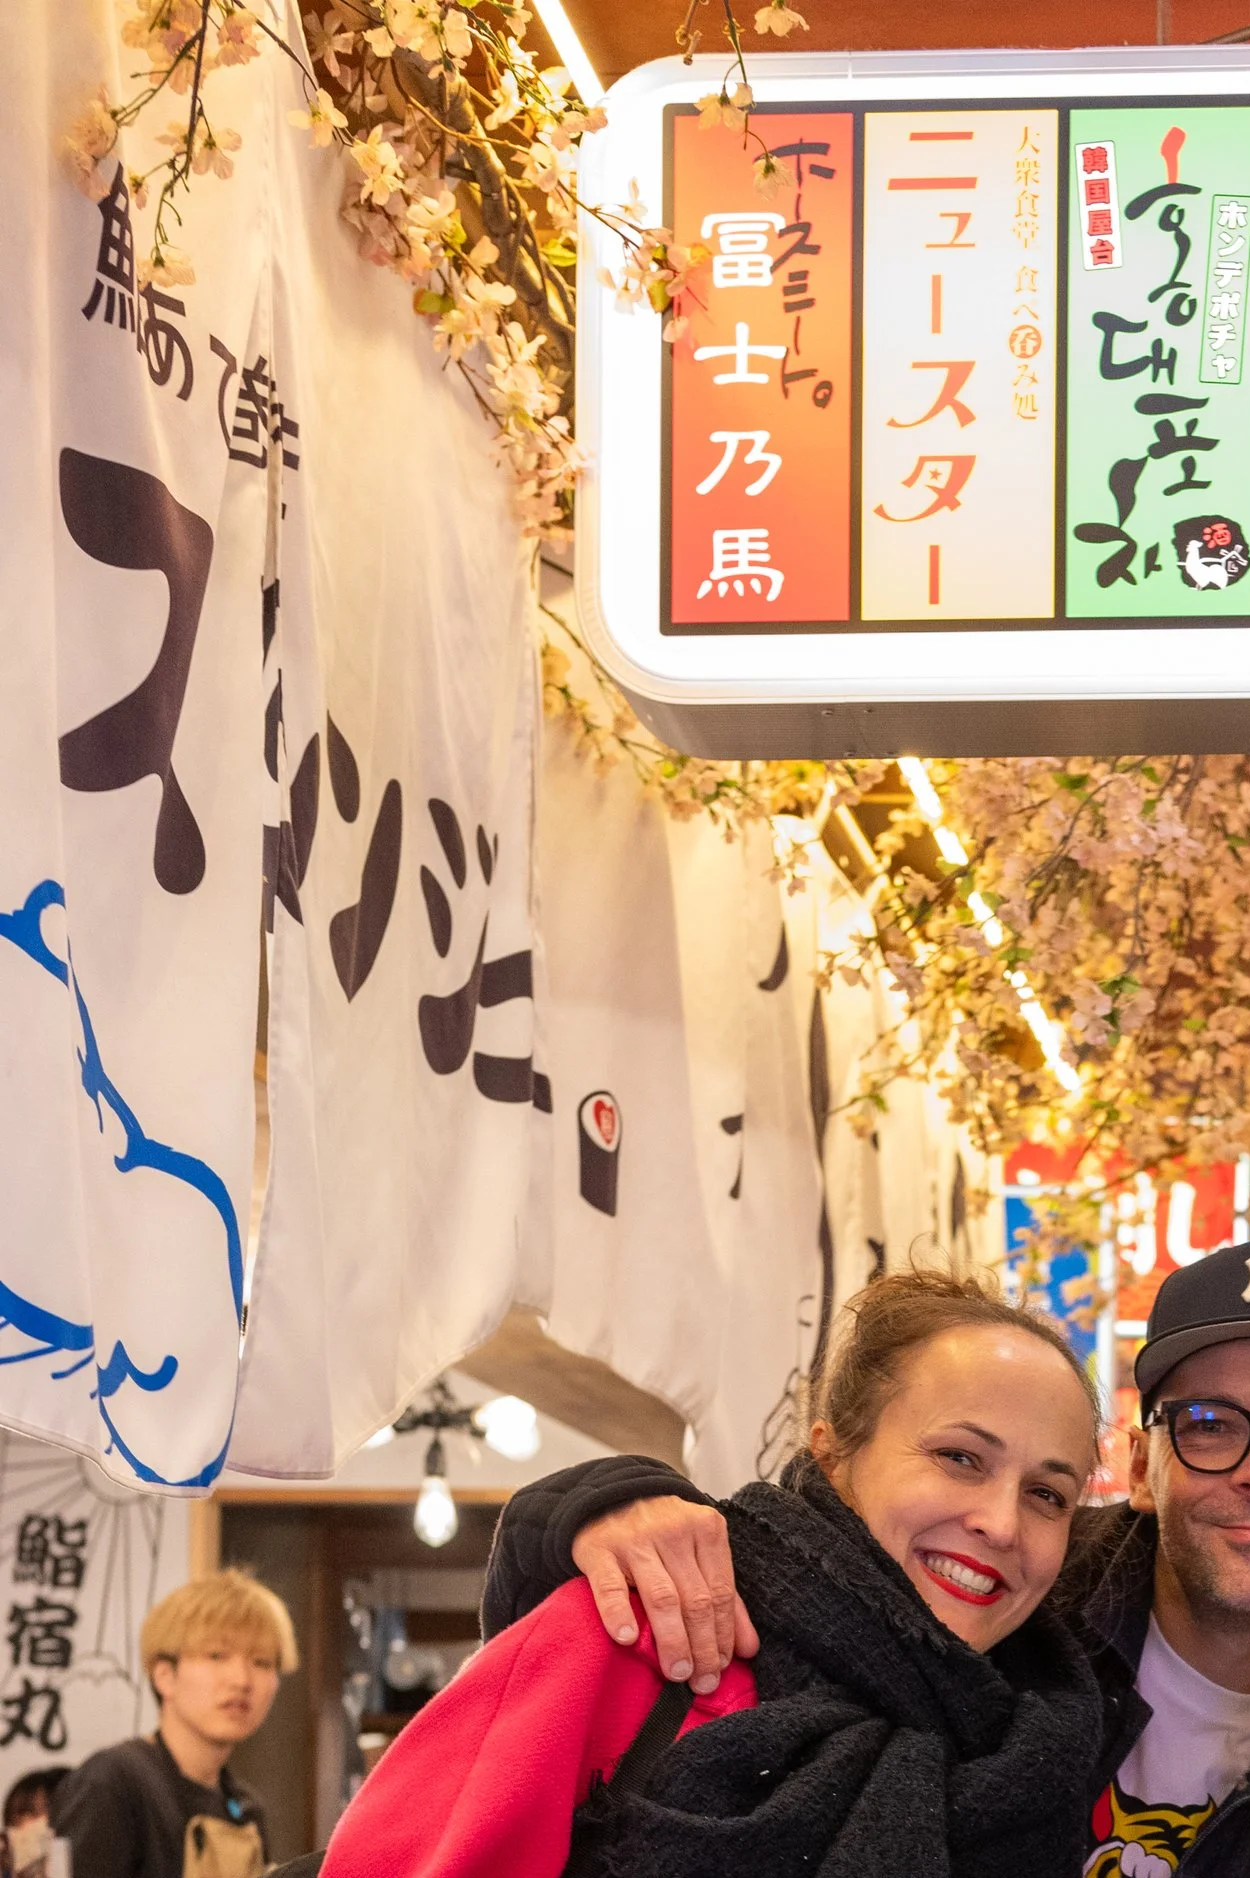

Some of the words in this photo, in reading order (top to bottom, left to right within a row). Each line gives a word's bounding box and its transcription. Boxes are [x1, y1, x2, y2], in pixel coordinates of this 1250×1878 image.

[1082, 146, 1116, 266] 韓国屋台
[1207, 200, 1249, 379] ホンデポチャ
[873, 131, 978, 605] ニュースター
